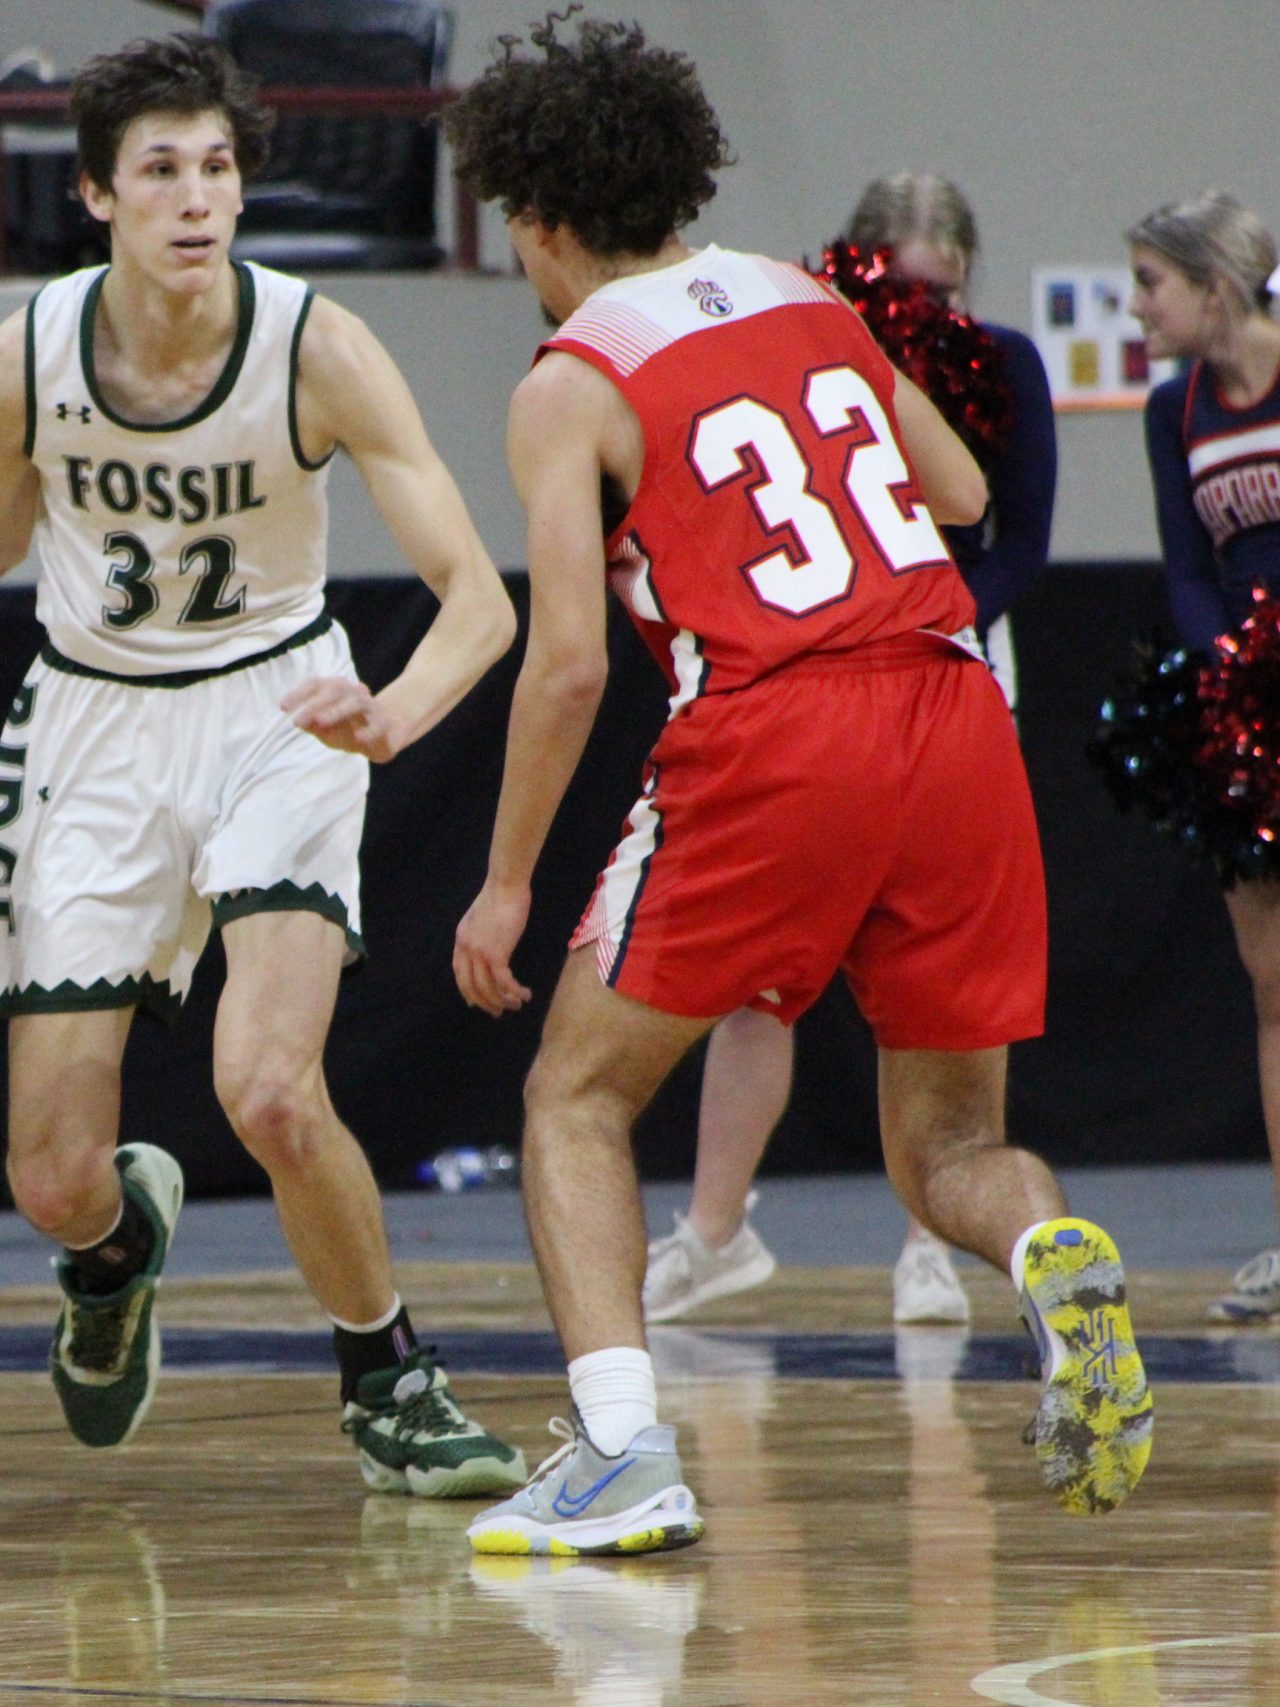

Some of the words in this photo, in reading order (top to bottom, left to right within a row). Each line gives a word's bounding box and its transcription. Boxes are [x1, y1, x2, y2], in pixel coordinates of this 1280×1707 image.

[62, 454, 268, 527] FOSSIL
[685, 362, 952, 620] 32
[102, 530, 248, 632] 32
